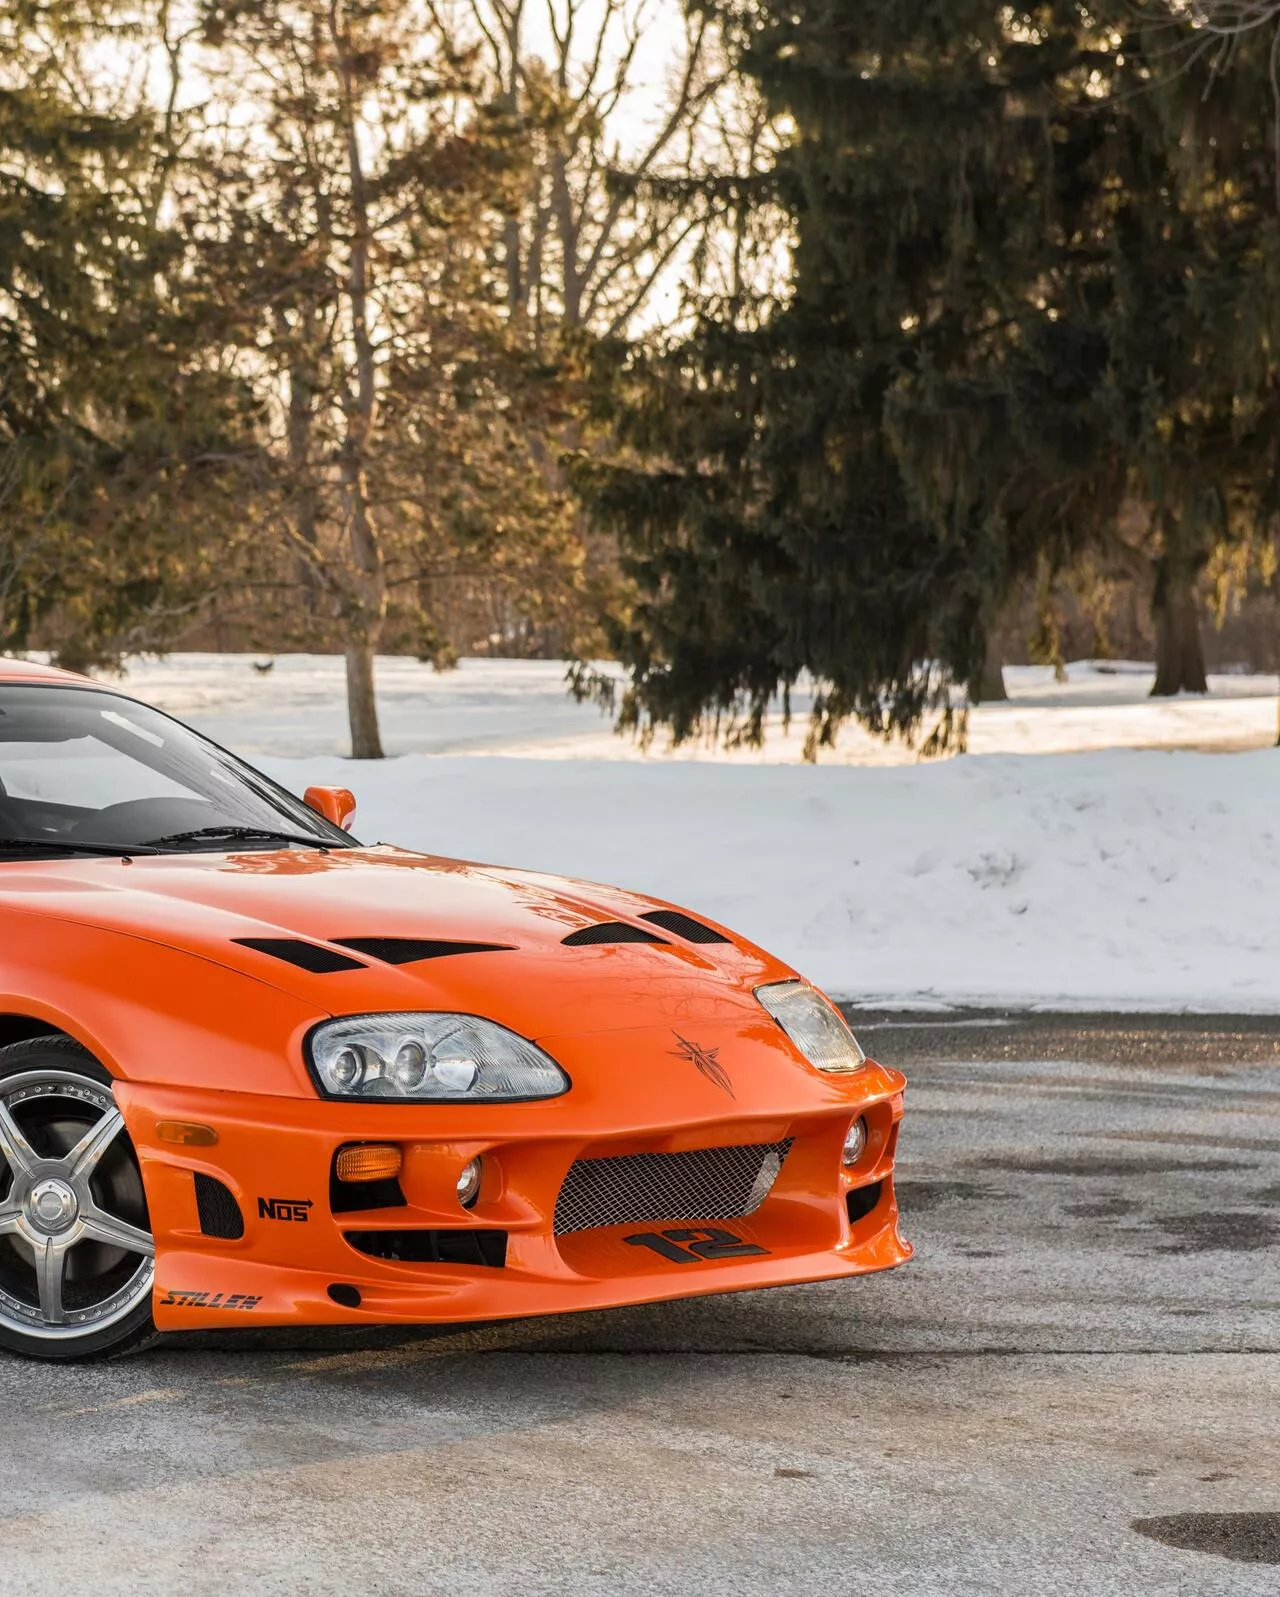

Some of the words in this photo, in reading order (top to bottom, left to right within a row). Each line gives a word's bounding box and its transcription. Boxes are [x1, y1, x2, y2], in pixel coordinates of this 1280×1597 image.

[257, 1197, 314, 1222] NOS
[623, 1228, 772, 1264] 12
[159, 1290, 263, 1310] STILLEN
